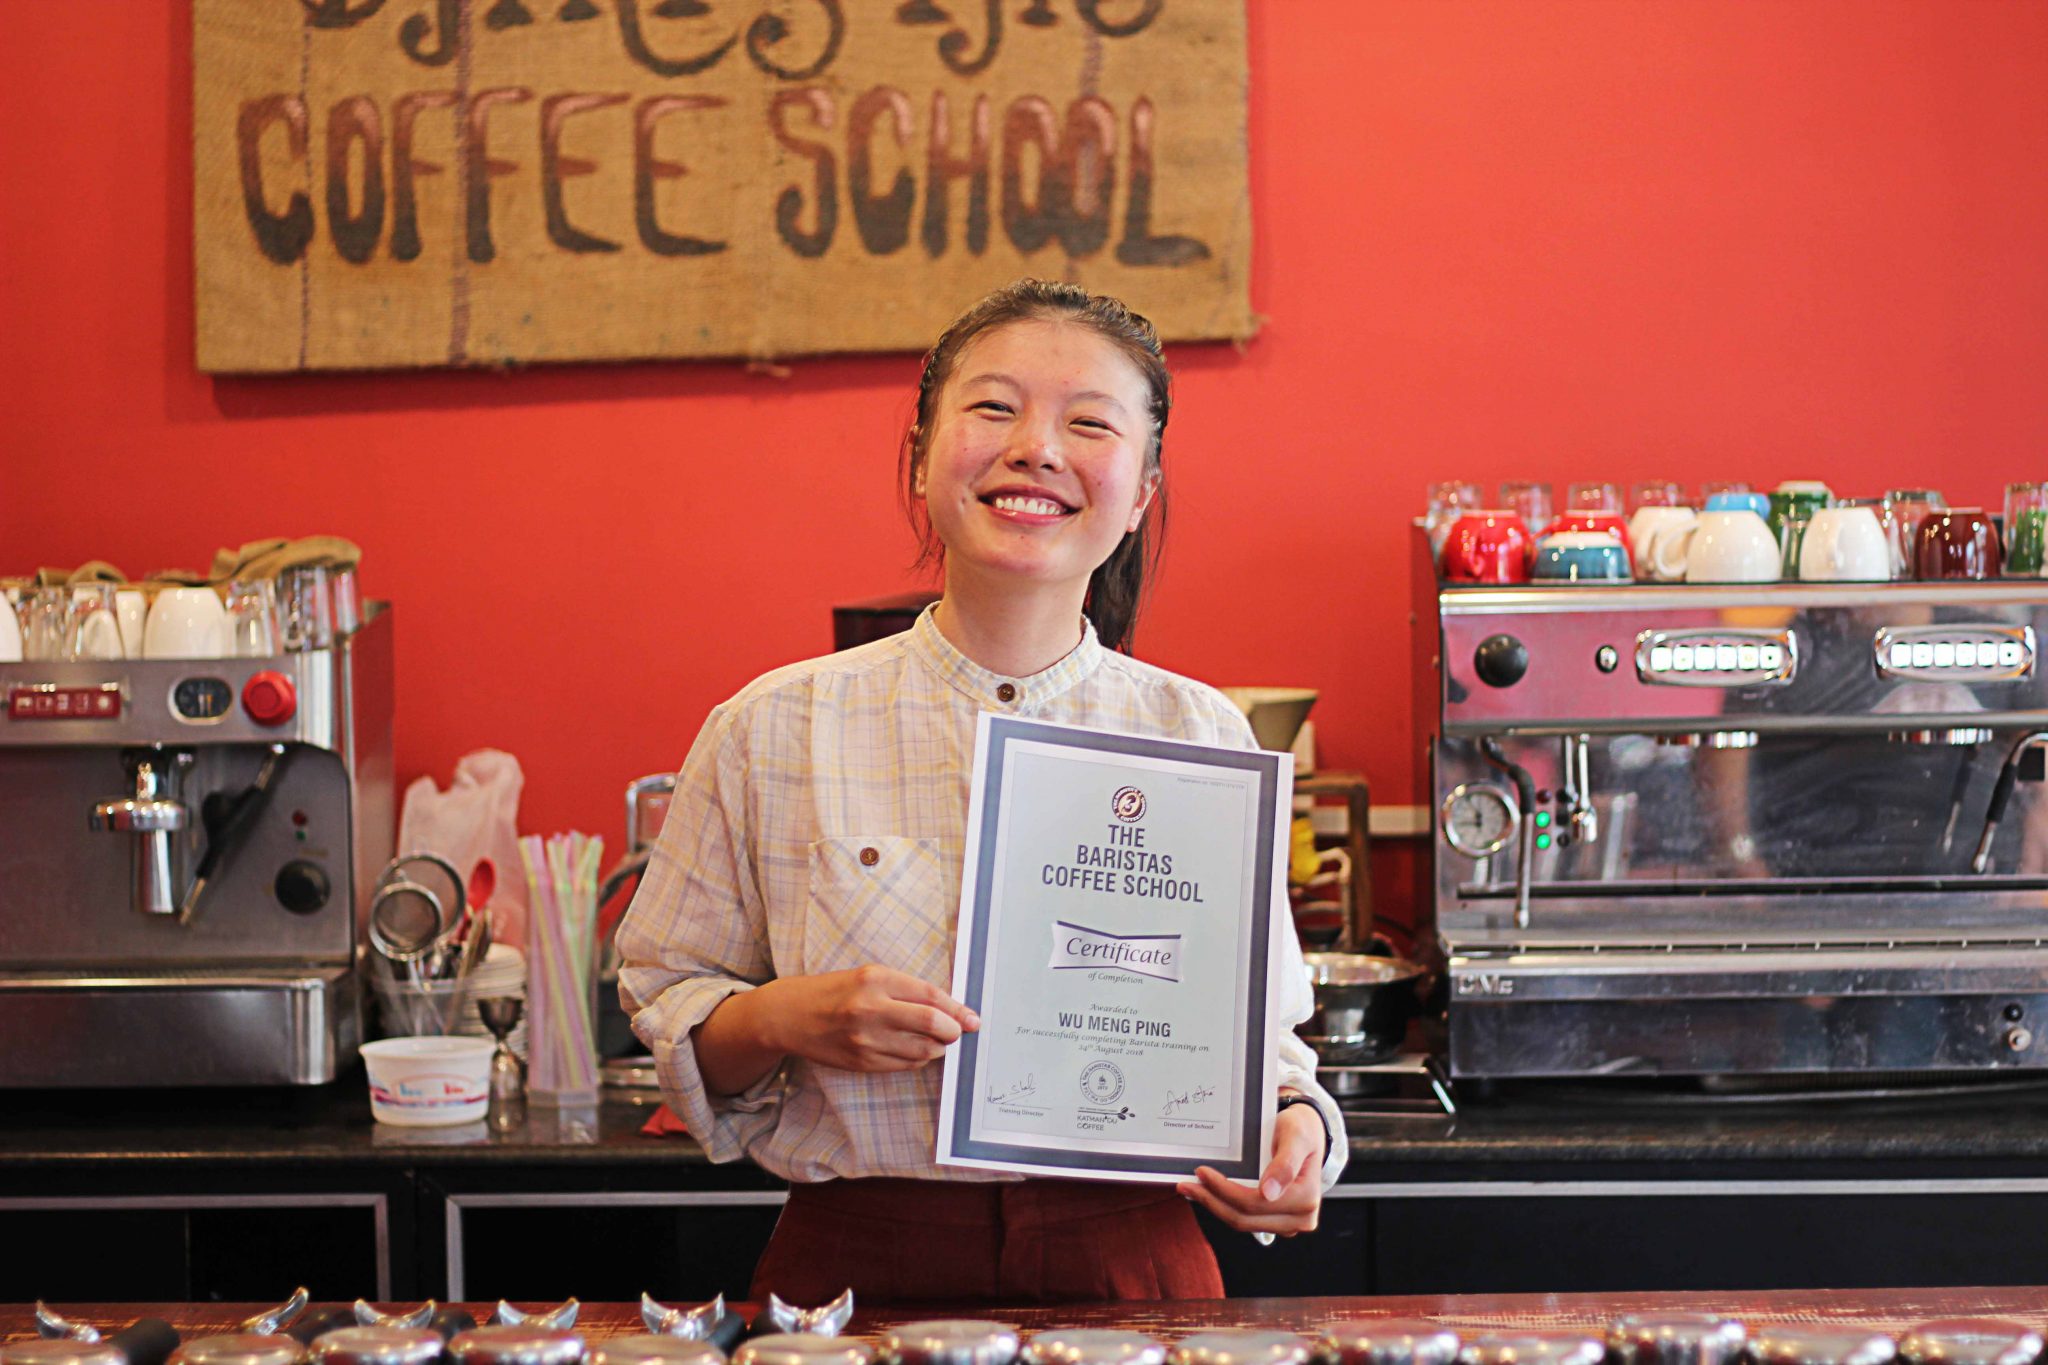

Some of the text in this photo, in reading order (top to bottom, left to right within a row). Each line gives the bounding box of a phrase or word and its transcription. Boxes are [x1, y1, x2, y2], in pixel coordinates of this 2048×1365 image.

[237, 85, 1211, 266] COFFEE SCHOOL
[1108, 824, 1145, 847] THE
[1076, 844, 1172, 875] BARISTAS
[1042, 864, 1204, 903] COFFEE SCHOOL
[1066, 937, 1171, 965] Certificate
[1088, 972, 1144, 984] of Completion
[1090, 1003, 1138, 1015] Awarded to
[1058, 1012, 1171, 1037] WU MENG PING
[1015, 1026, 1031, 1035] For
[1032, 1028, 1079, 1041] successfully
[1081, 1034, 1127, 1046] completing
[1129, 1038, 1159, 1048] Barista
[1162, 1041, 1196, 1052] training
[1094, 1044, 1123, 1055] August
[1021, 1109, 1044, 1117] Director
[1077, 1122, 1104, 1131] COFFEE
